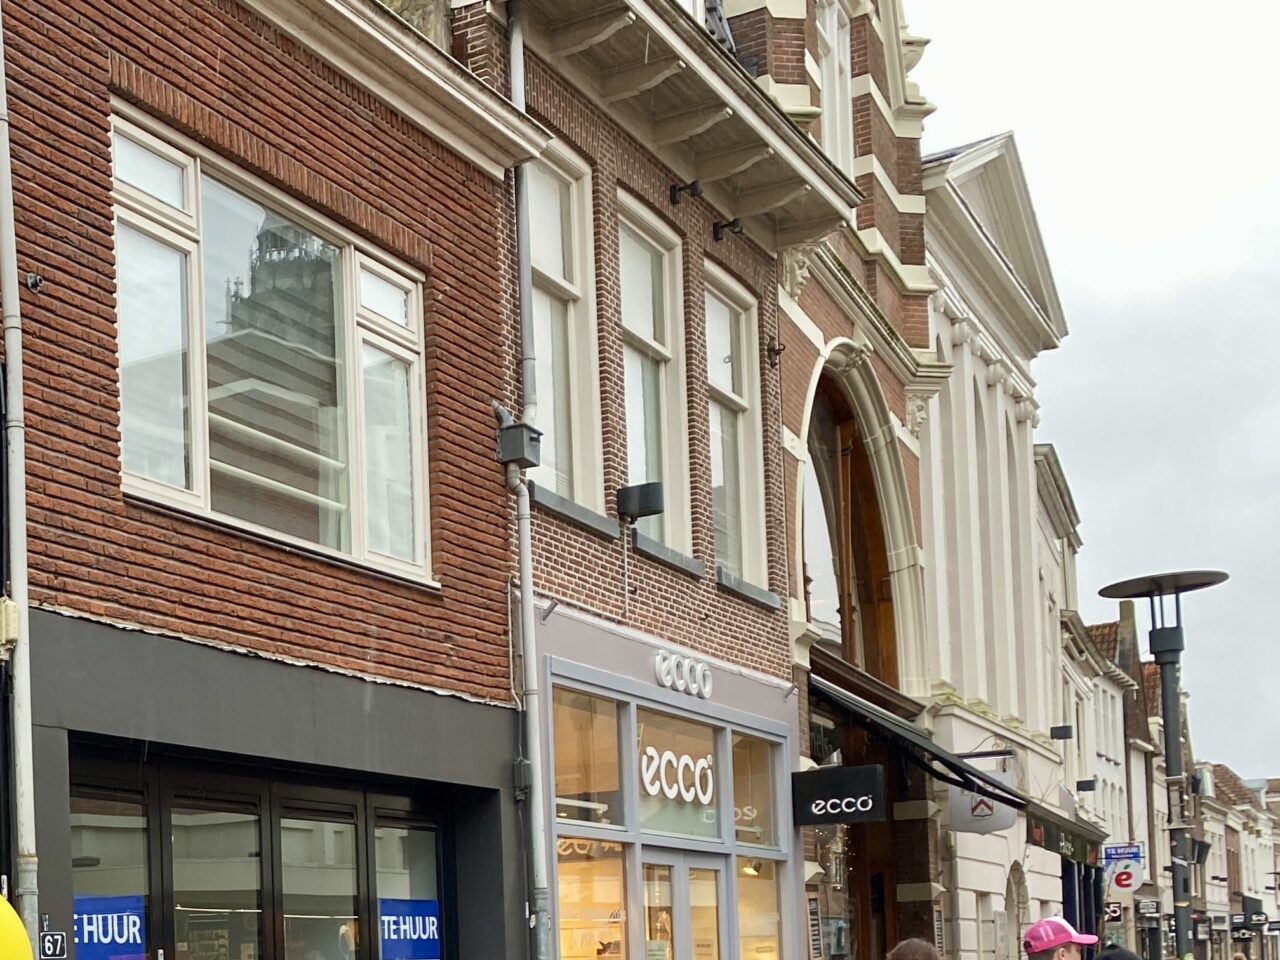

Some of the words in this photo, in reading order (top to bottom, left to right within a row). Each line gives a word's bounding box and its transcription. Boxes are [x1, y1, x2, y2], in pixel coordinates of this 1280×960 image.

[654, 650, 713, 699] ecco
[641, 746, 714, 806] ecco
[811, 795, 873, 815] ecco
[83, 914, 142, 944] HUUR
[381, 916, 397, 940] TE
[400, 916, 439, 940] HUUR
[44, 935, 62, 956] 67
